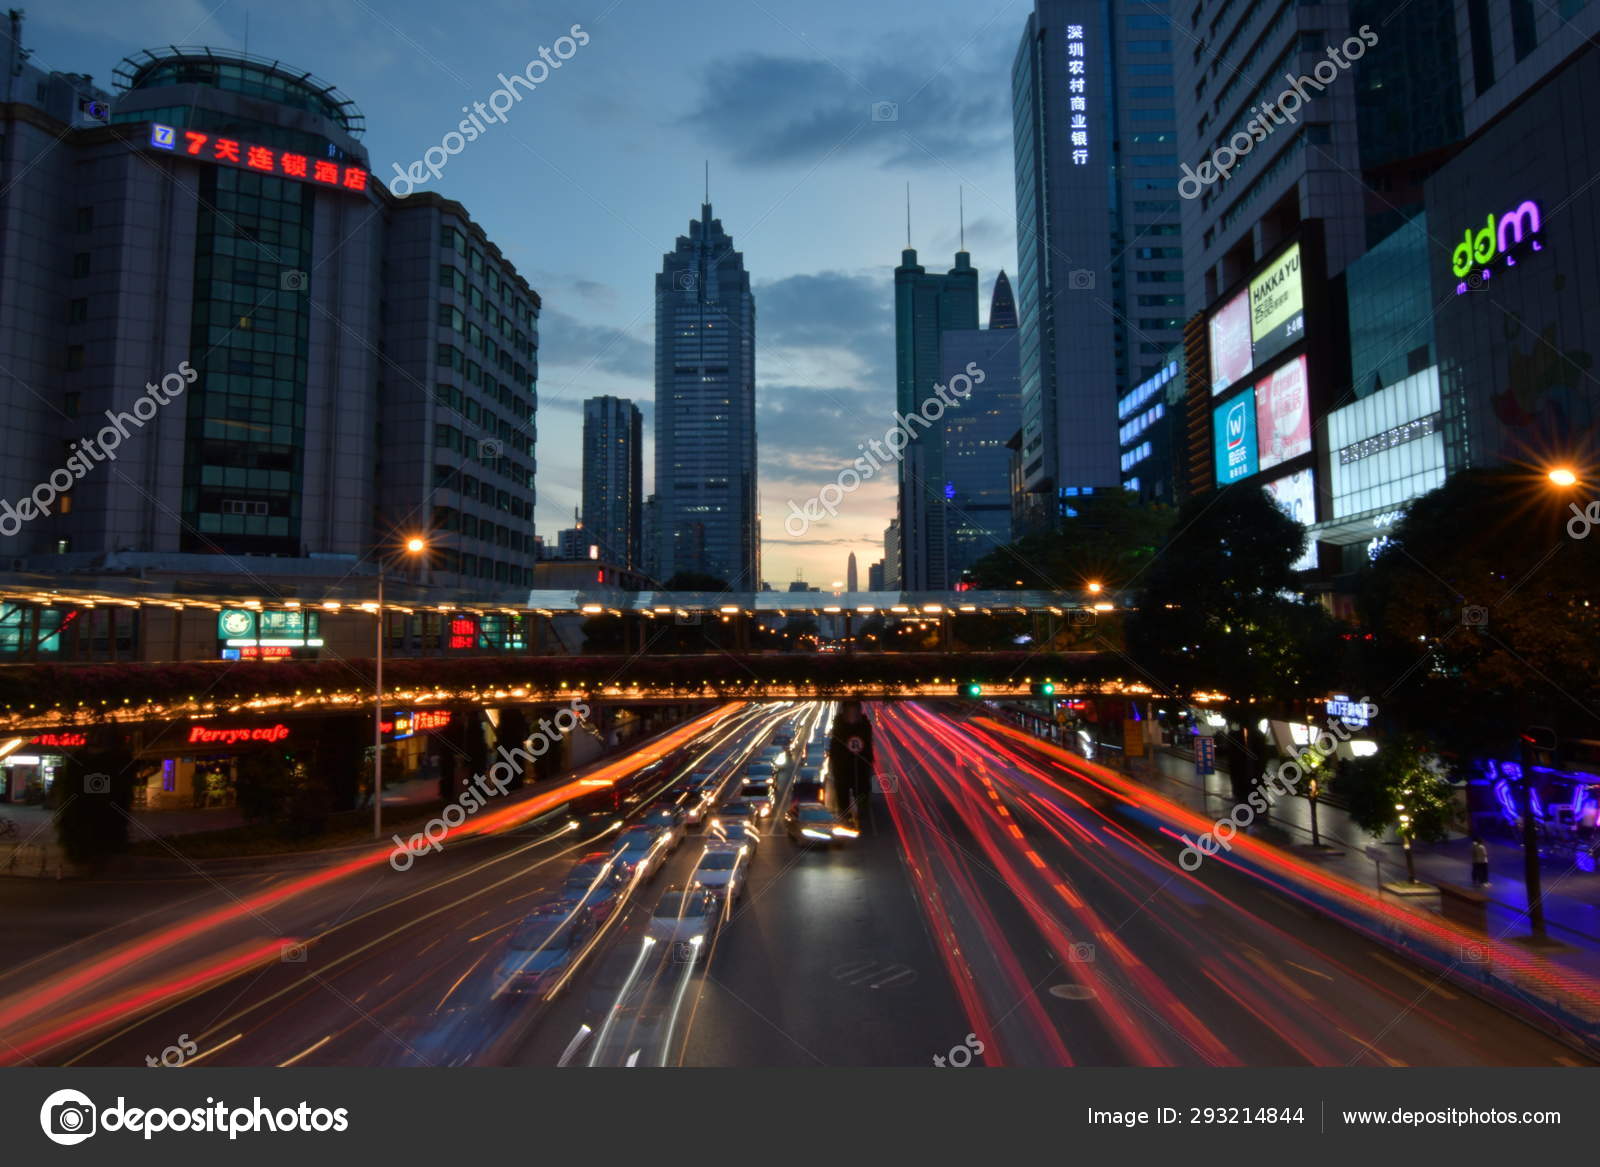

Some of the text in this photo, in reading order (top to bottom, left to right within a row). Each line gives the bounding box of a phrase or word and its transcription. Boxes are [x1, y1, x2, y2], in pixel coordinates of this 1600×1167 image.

[1067, 25, 1088, 165] 深圳农村商业银行
[185, 131, 367, 190] 7天连锁酒店
[1453, 201, 1540, 278] ddm
[189, 724, 289, 744] Perrys cafe
